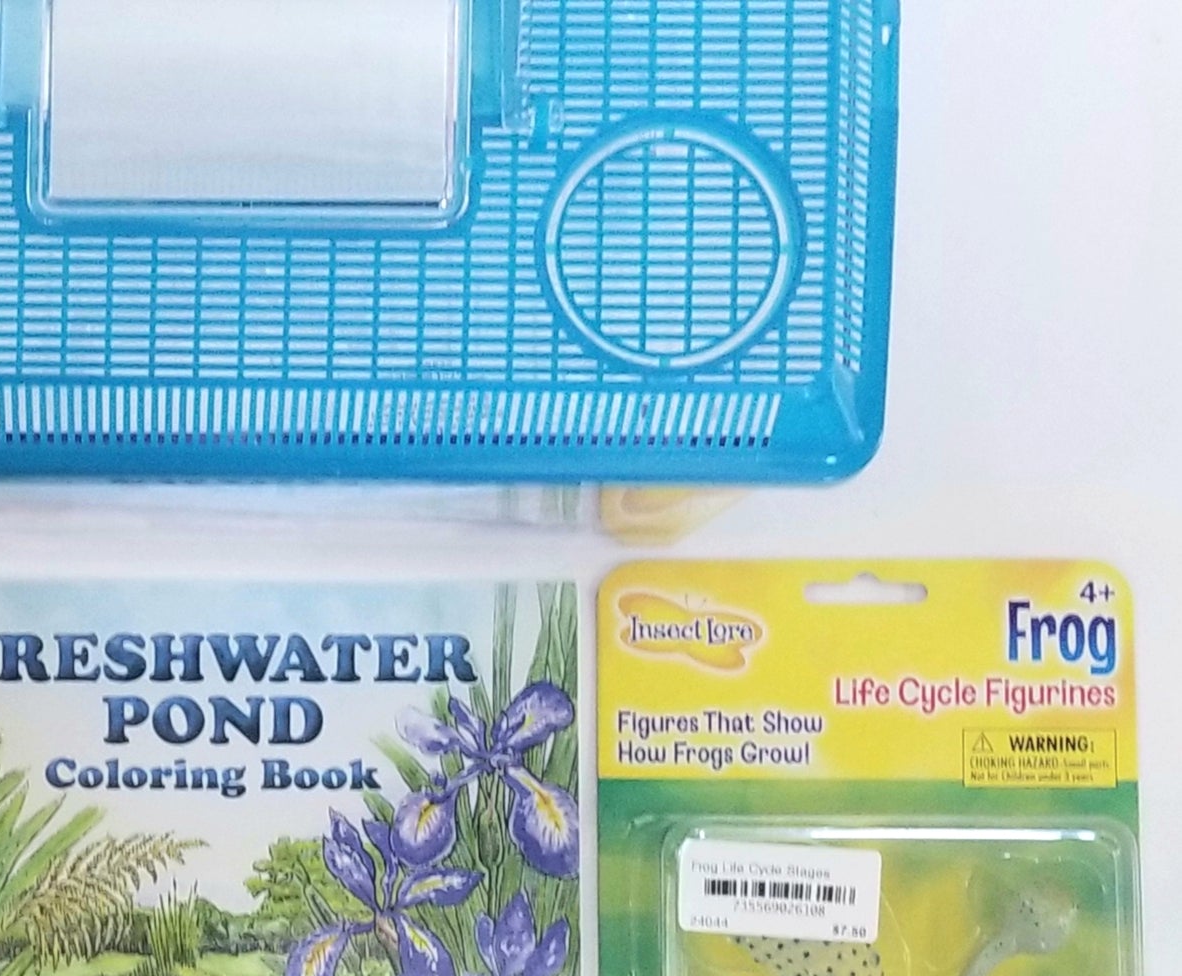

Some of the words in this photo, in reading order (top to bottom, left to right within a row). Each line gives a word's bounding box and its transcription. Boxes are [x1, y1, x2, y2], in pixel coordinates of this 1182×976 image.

[1079, 580, 1115, 603] 4+
[630, 615, 702, 642] Insect
[1007, 600, 1117, 675] Frog
[835, 677, 890, 706] Life
[898, 677, 977, 714] Cycle
[986, 677, 1116, 715] Figurines
[102, 695, 325, 745] POND
[618, 710, 699, 740] Figures
[703, 710, 756, 734] That
[763, 710, 823, 734] Show
[618, 741, 667, 764] How
[674, 741, 733, 771] Frogs
[969, 756, 1016, 769] CHOKING
[45, 757, 248, 798] Coloring
[261, 758, 382, 790] Book
[691, 861, 719, 876] Frog
[722, 862, 744, 874] Life
[748, 863, 782, 878] Cycle
[786, 865, 831, 880] Stages
